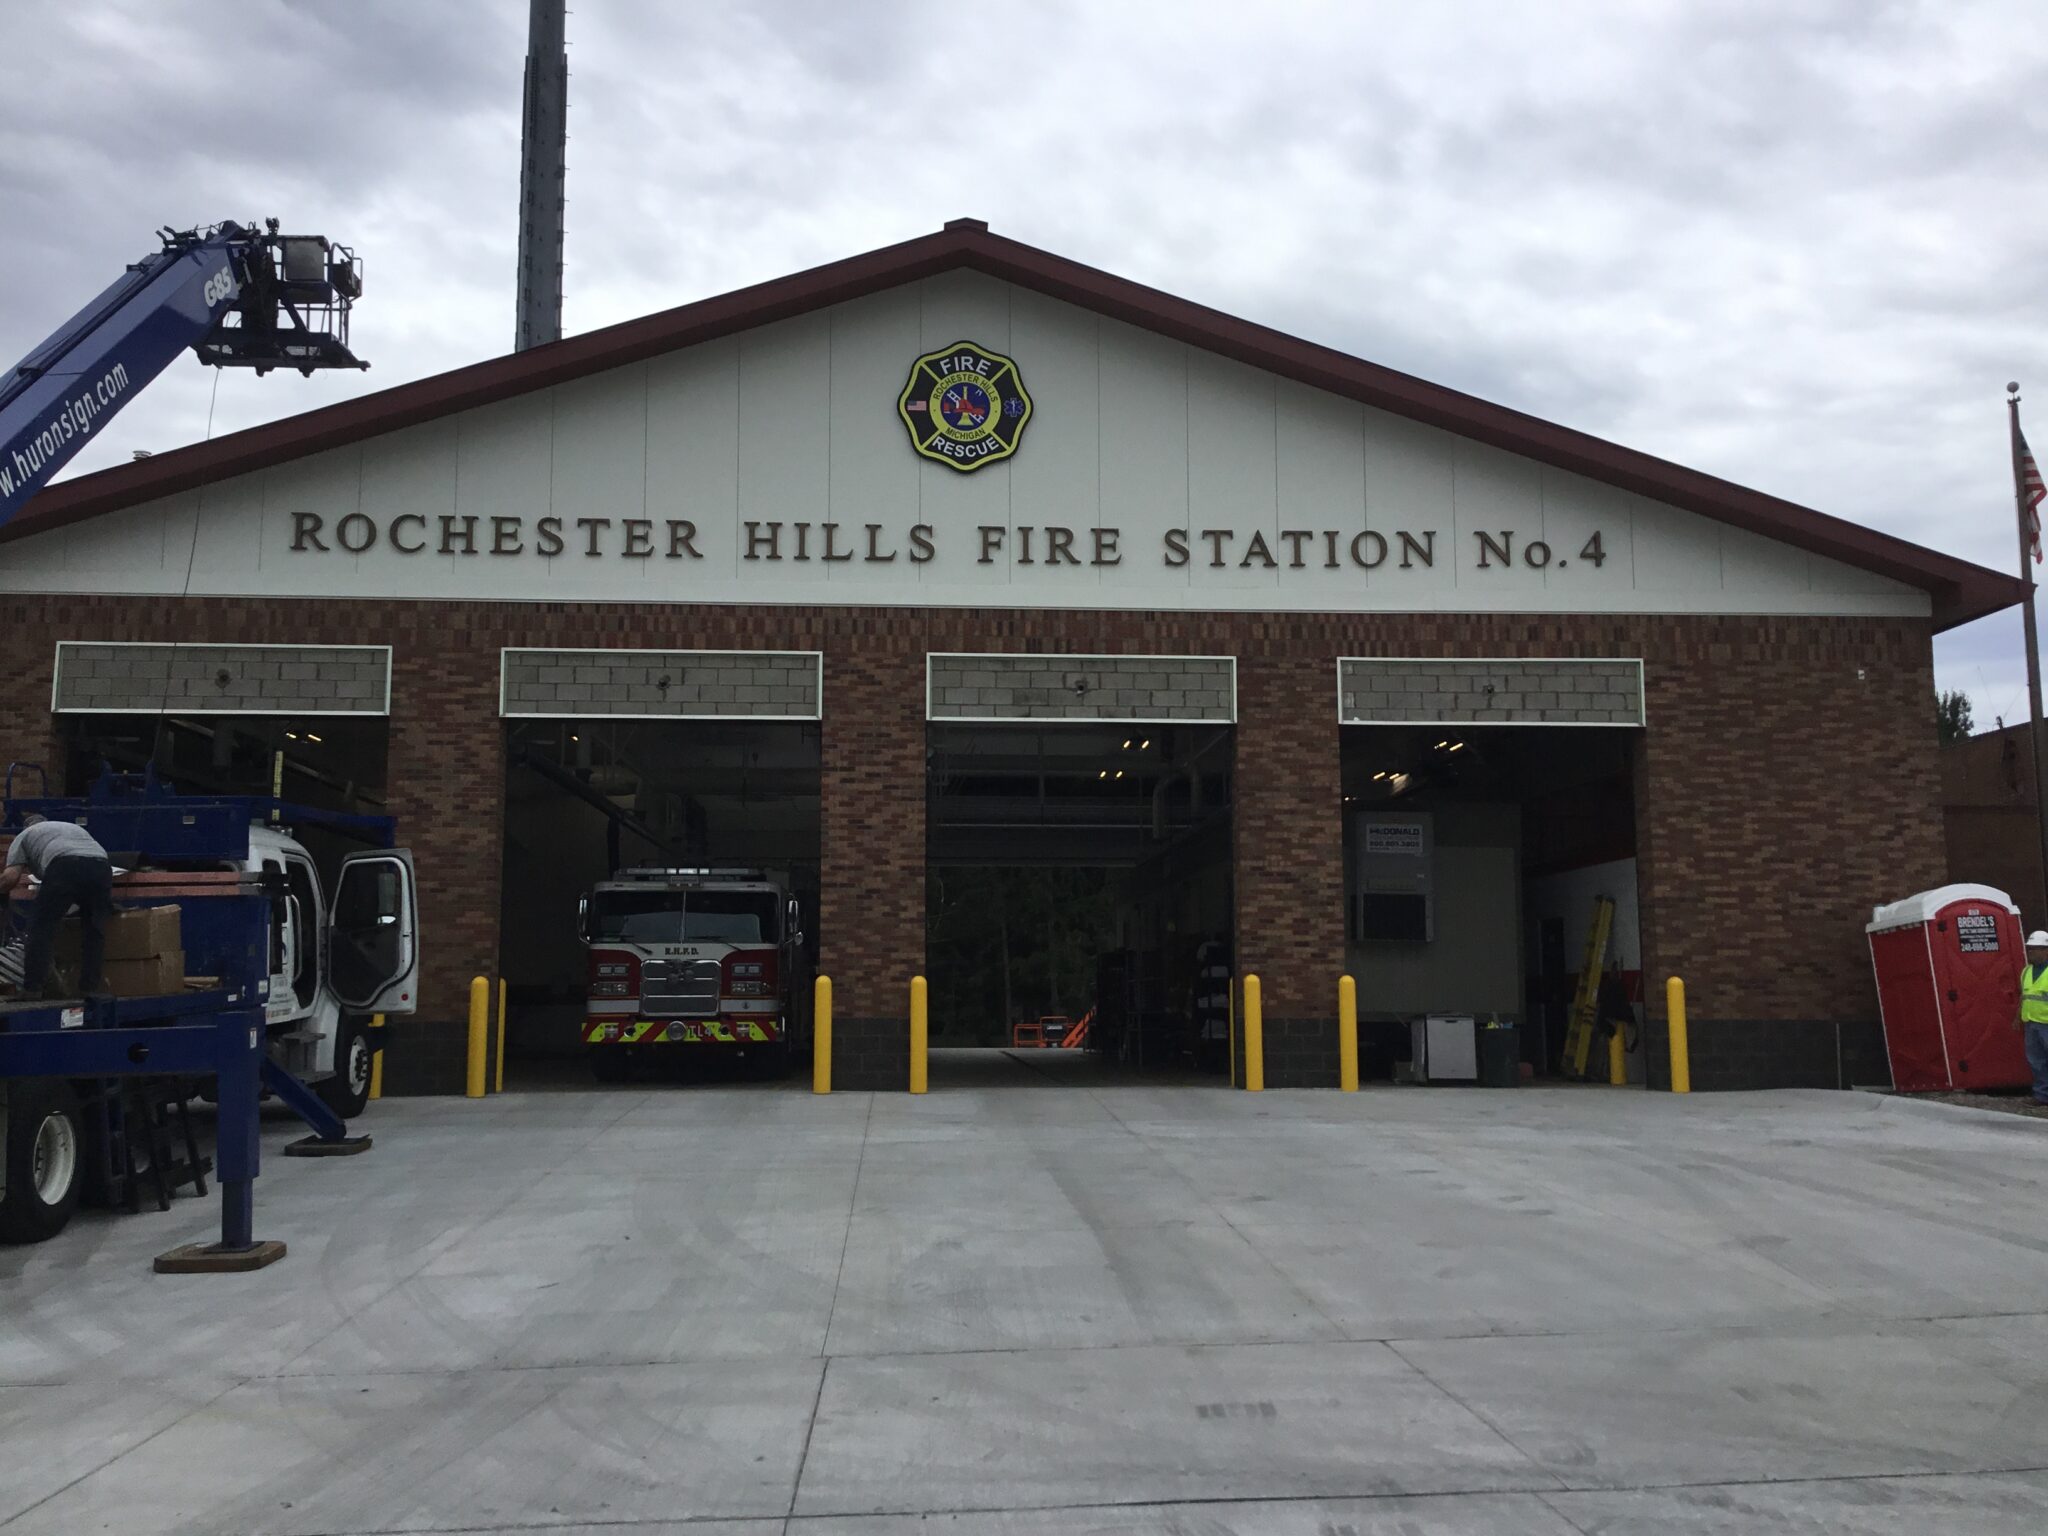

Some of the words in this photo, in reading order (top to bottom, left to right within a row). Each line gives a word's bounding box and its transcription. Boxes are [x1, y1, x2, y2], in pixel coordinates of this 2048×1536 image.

[203, 266, 232, 307] G85
[939, 356, 991, 376] FIRE
[933, 373, 980, 400] ROCHESTER
[980, 379, 998, 402] HILLS
[945, 427, 986, 440] MICHIGAN
[932, 436, 999, 458] RESCUE
[291, 511, 704, 560] ROCHESTER
[743, 520, 936, 563] HILLS
[977, 525, 1123, 567] FIRE
[1164, 528, 1437, 569] STATION
